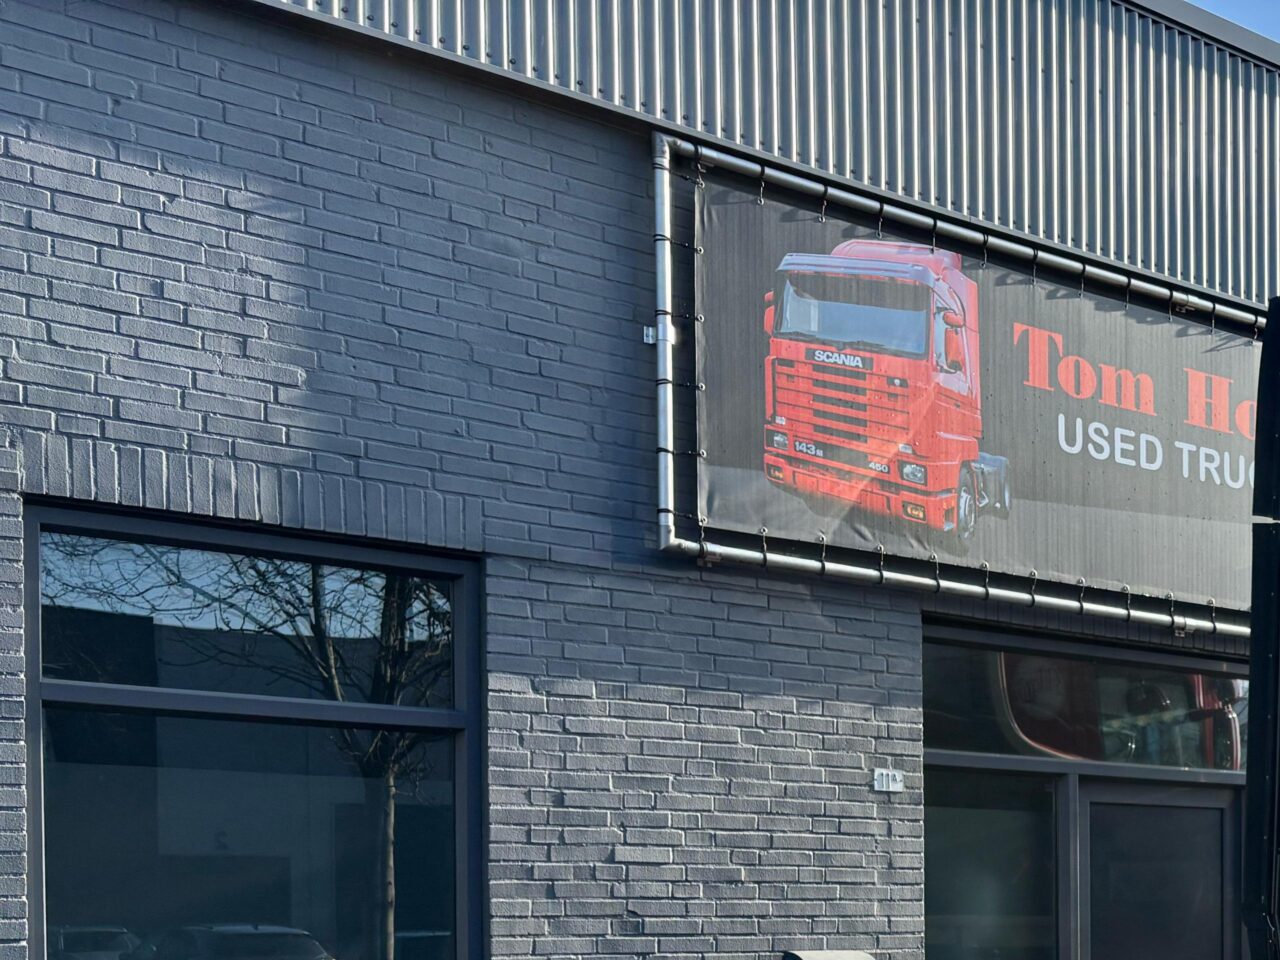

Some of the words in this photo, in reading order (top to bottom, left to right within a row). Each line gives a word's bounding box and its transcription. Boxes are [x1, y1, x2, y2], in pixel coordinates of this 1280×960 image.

[814, 350, 863, 368] SCANIA
[1013, 322, 1157, 416] Tom
[1058, 413, 1163, 471] USED
